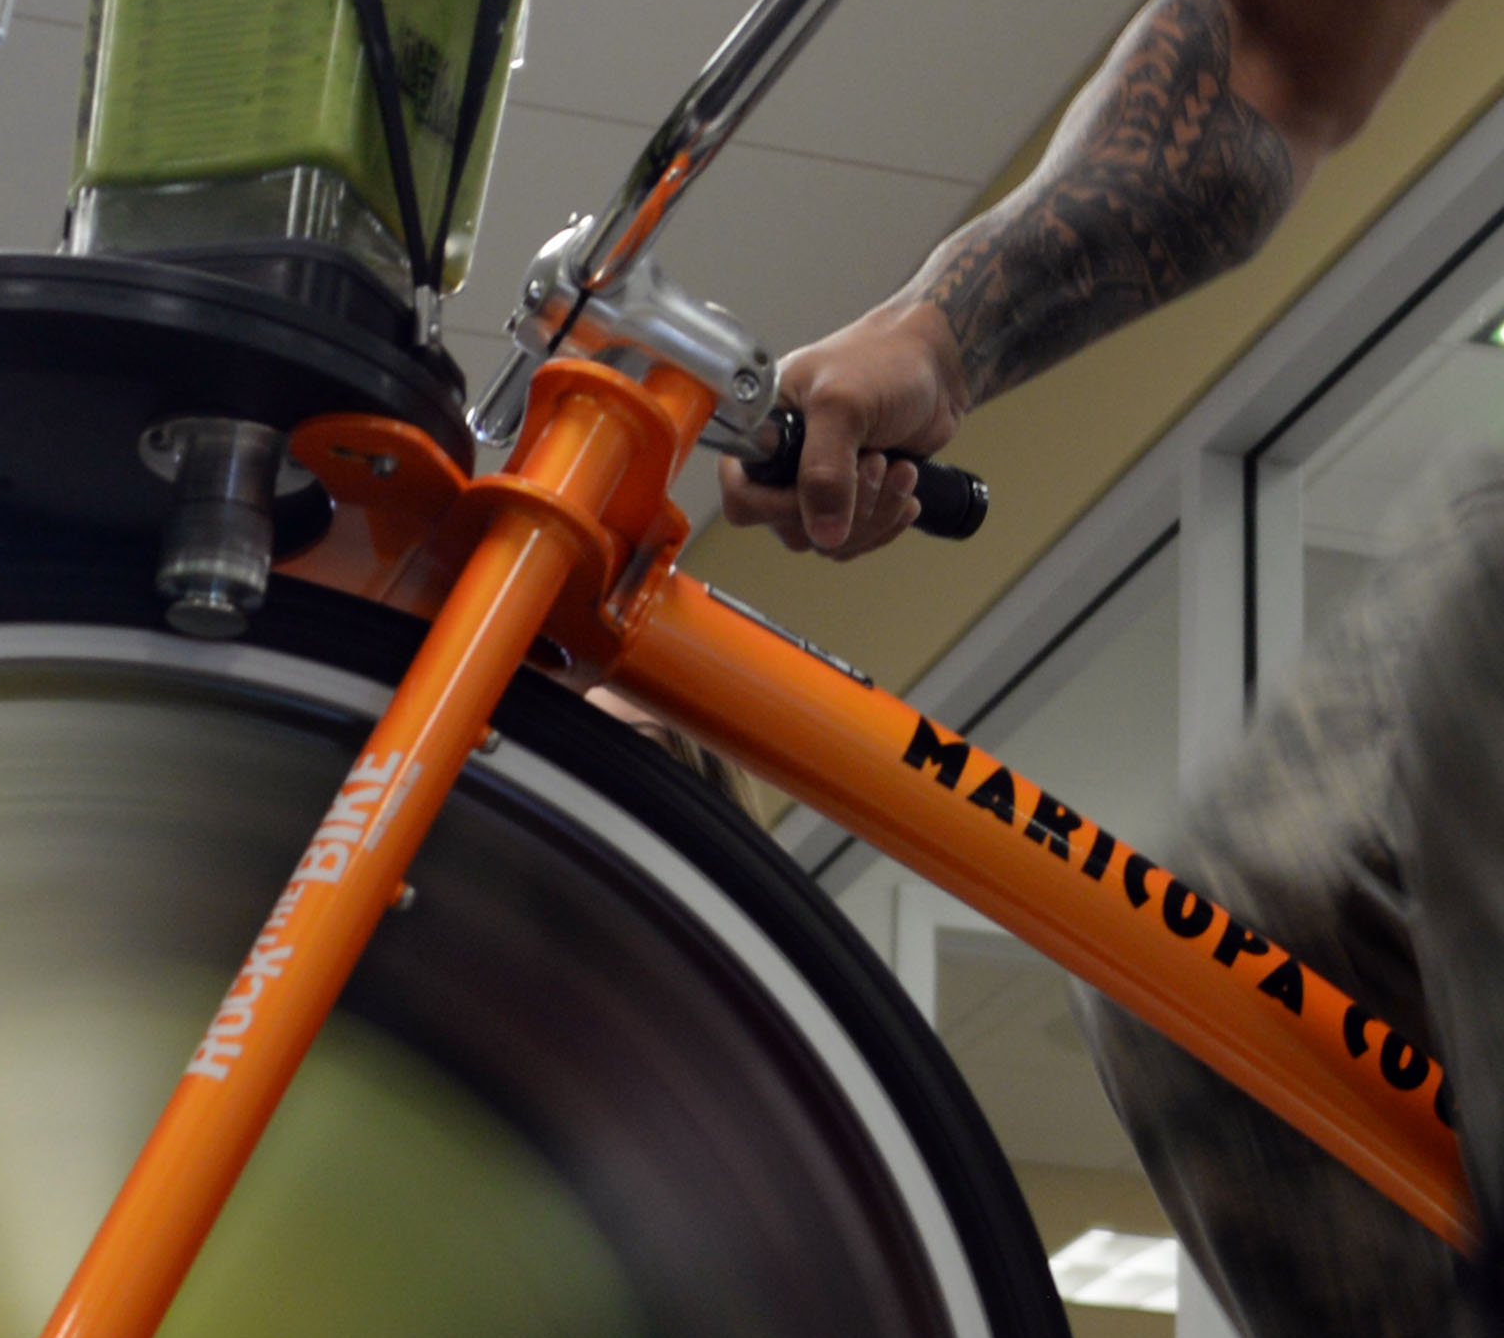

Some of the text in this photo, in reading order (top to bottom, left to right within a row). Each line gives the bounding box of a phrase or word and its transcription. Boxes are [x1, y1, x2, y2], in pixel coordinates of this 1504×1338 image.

[185, 945, 295, 1081] ROCK
[290, 749, 403, 884] BIKE
[901, 715, 1305, 1016] MARICOPA
